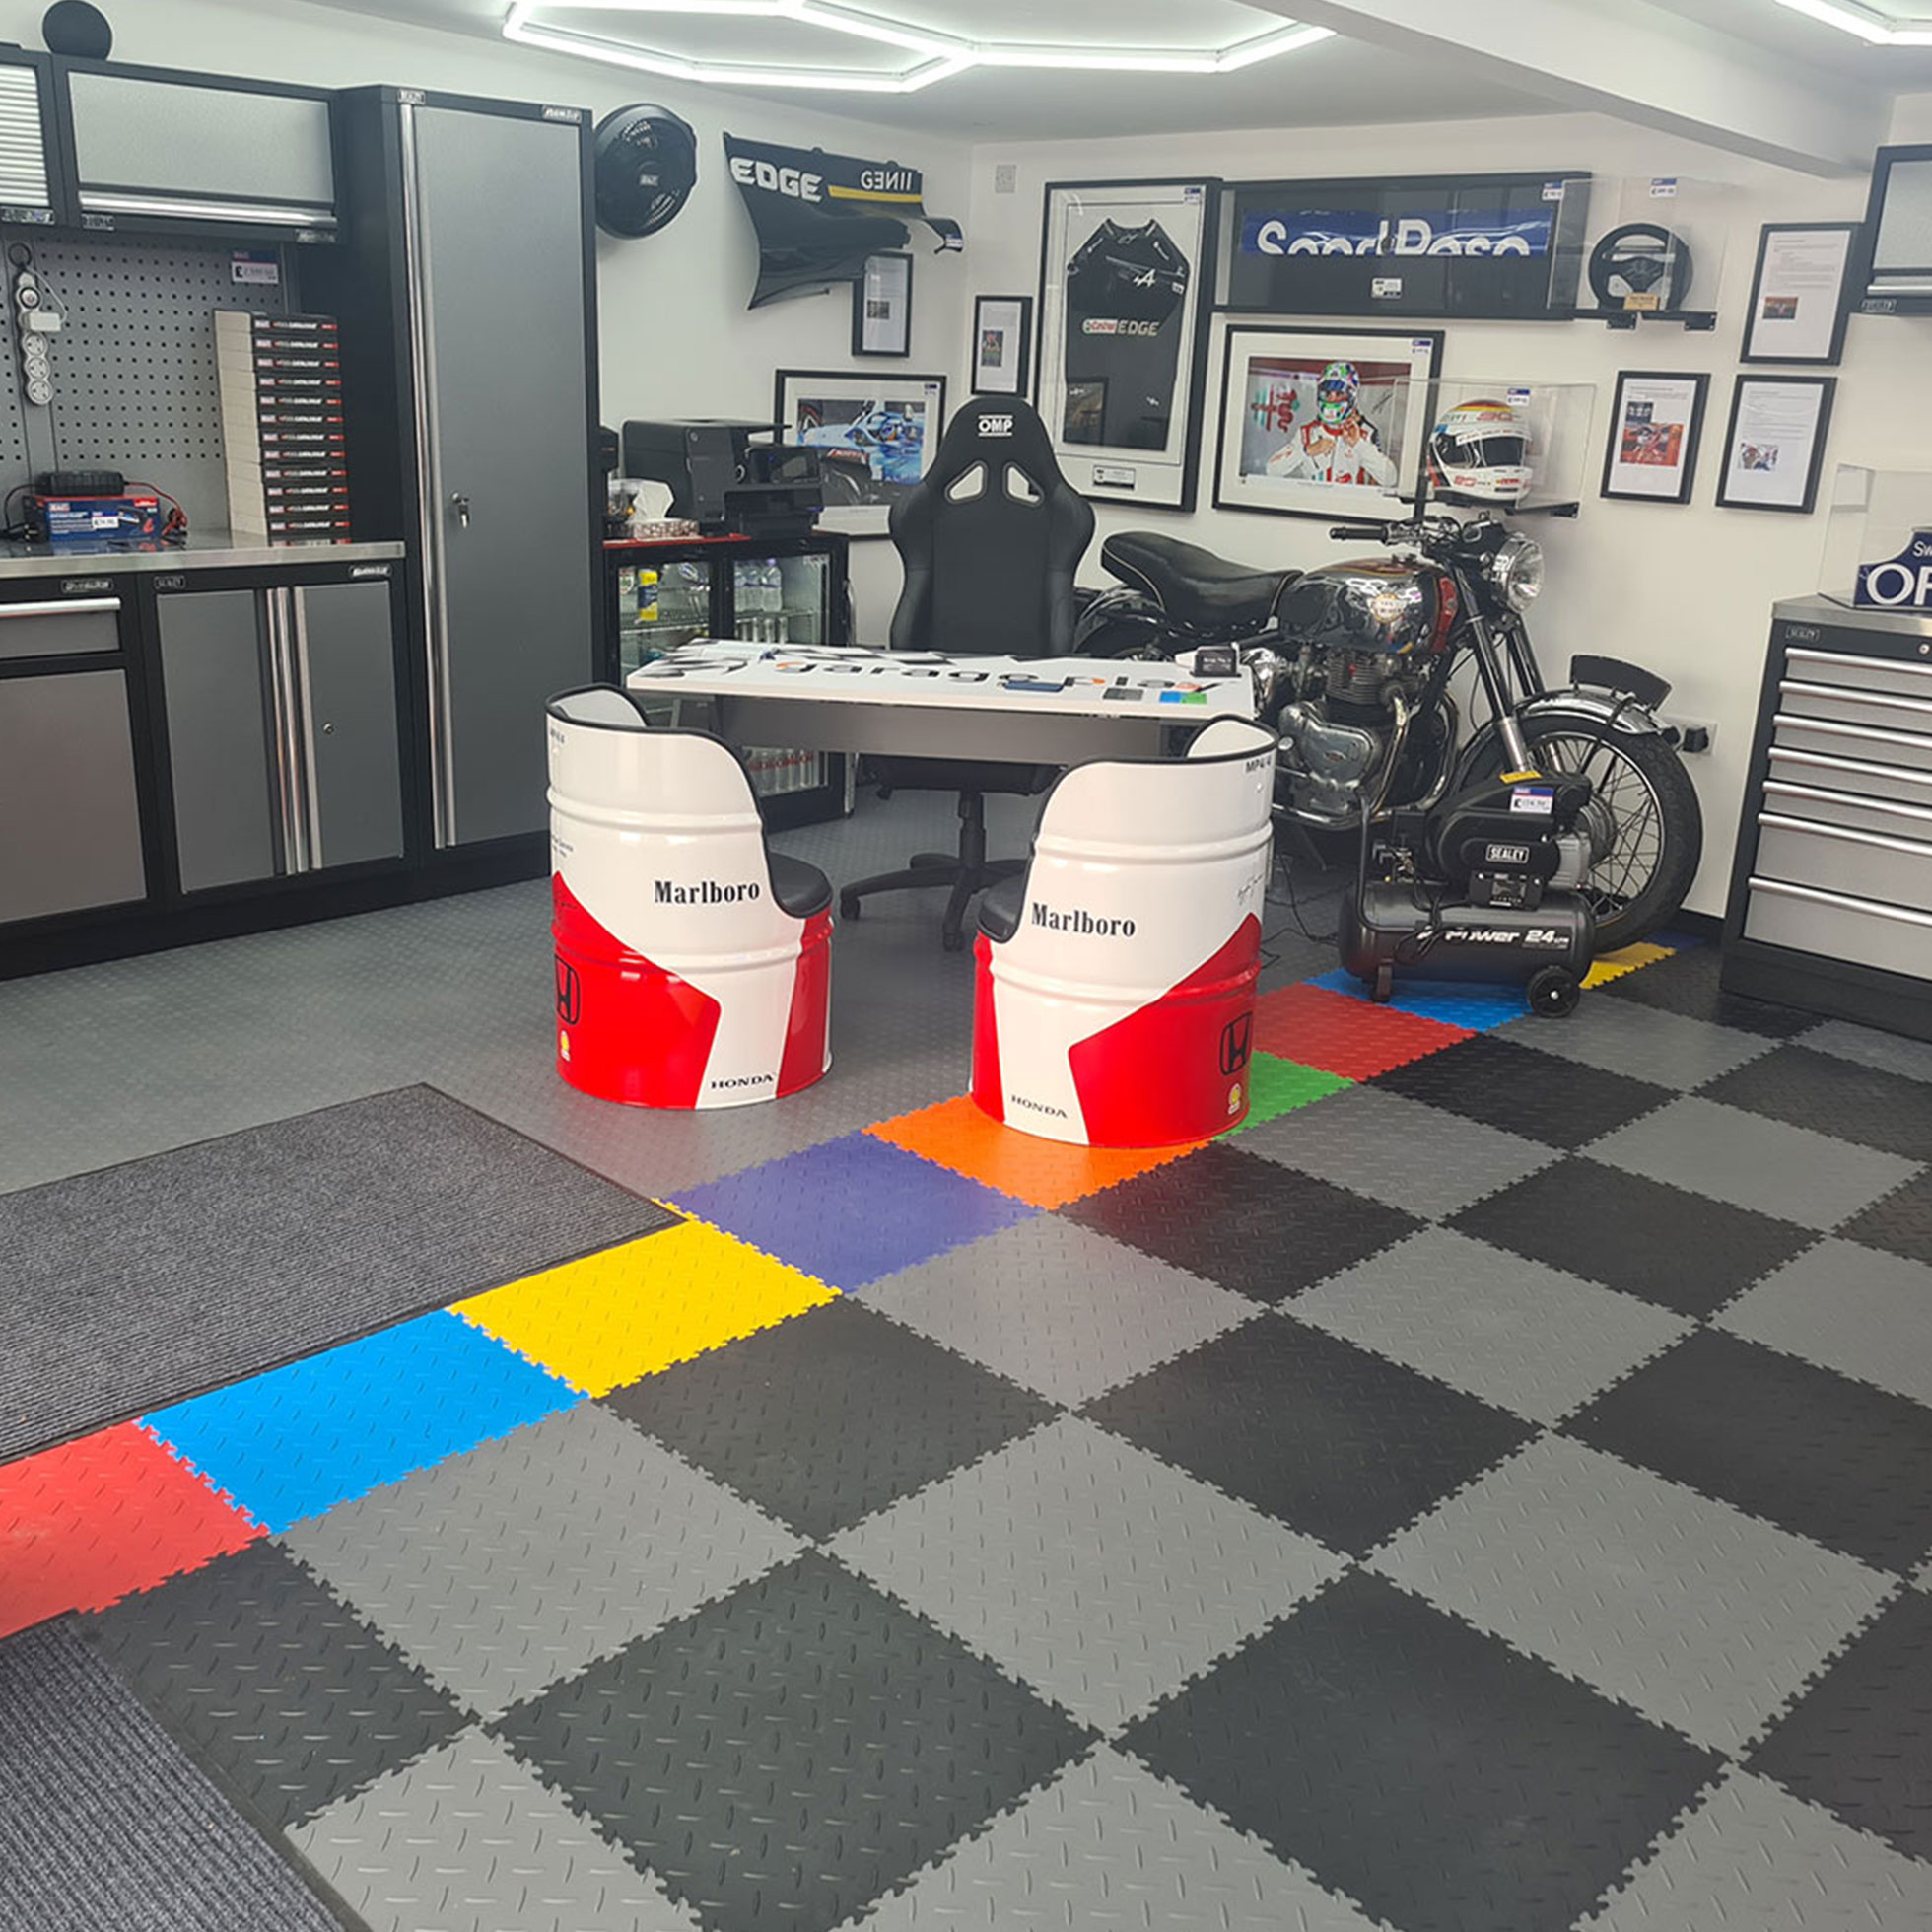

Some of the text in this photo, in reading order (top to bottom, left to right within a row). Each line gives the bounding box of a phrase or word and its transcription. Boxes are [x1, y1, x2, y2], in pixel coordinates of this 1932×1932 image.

[730, 156, 823, 203] EDGE
[1117, 319, 1160, 336] EDGE
[978, 418, 1013, 433] OMP
[1490, 846, 1526, 861] SEALEY
[654, 879, 761, 905] Marlboro
[1031, 901, 1137, 937] Marlboro
[1524, 929, 1556, 943] 24
[710, 1072, 775, 1090] HONDA
[1010, 1093, 1069, 1120] HONDA
